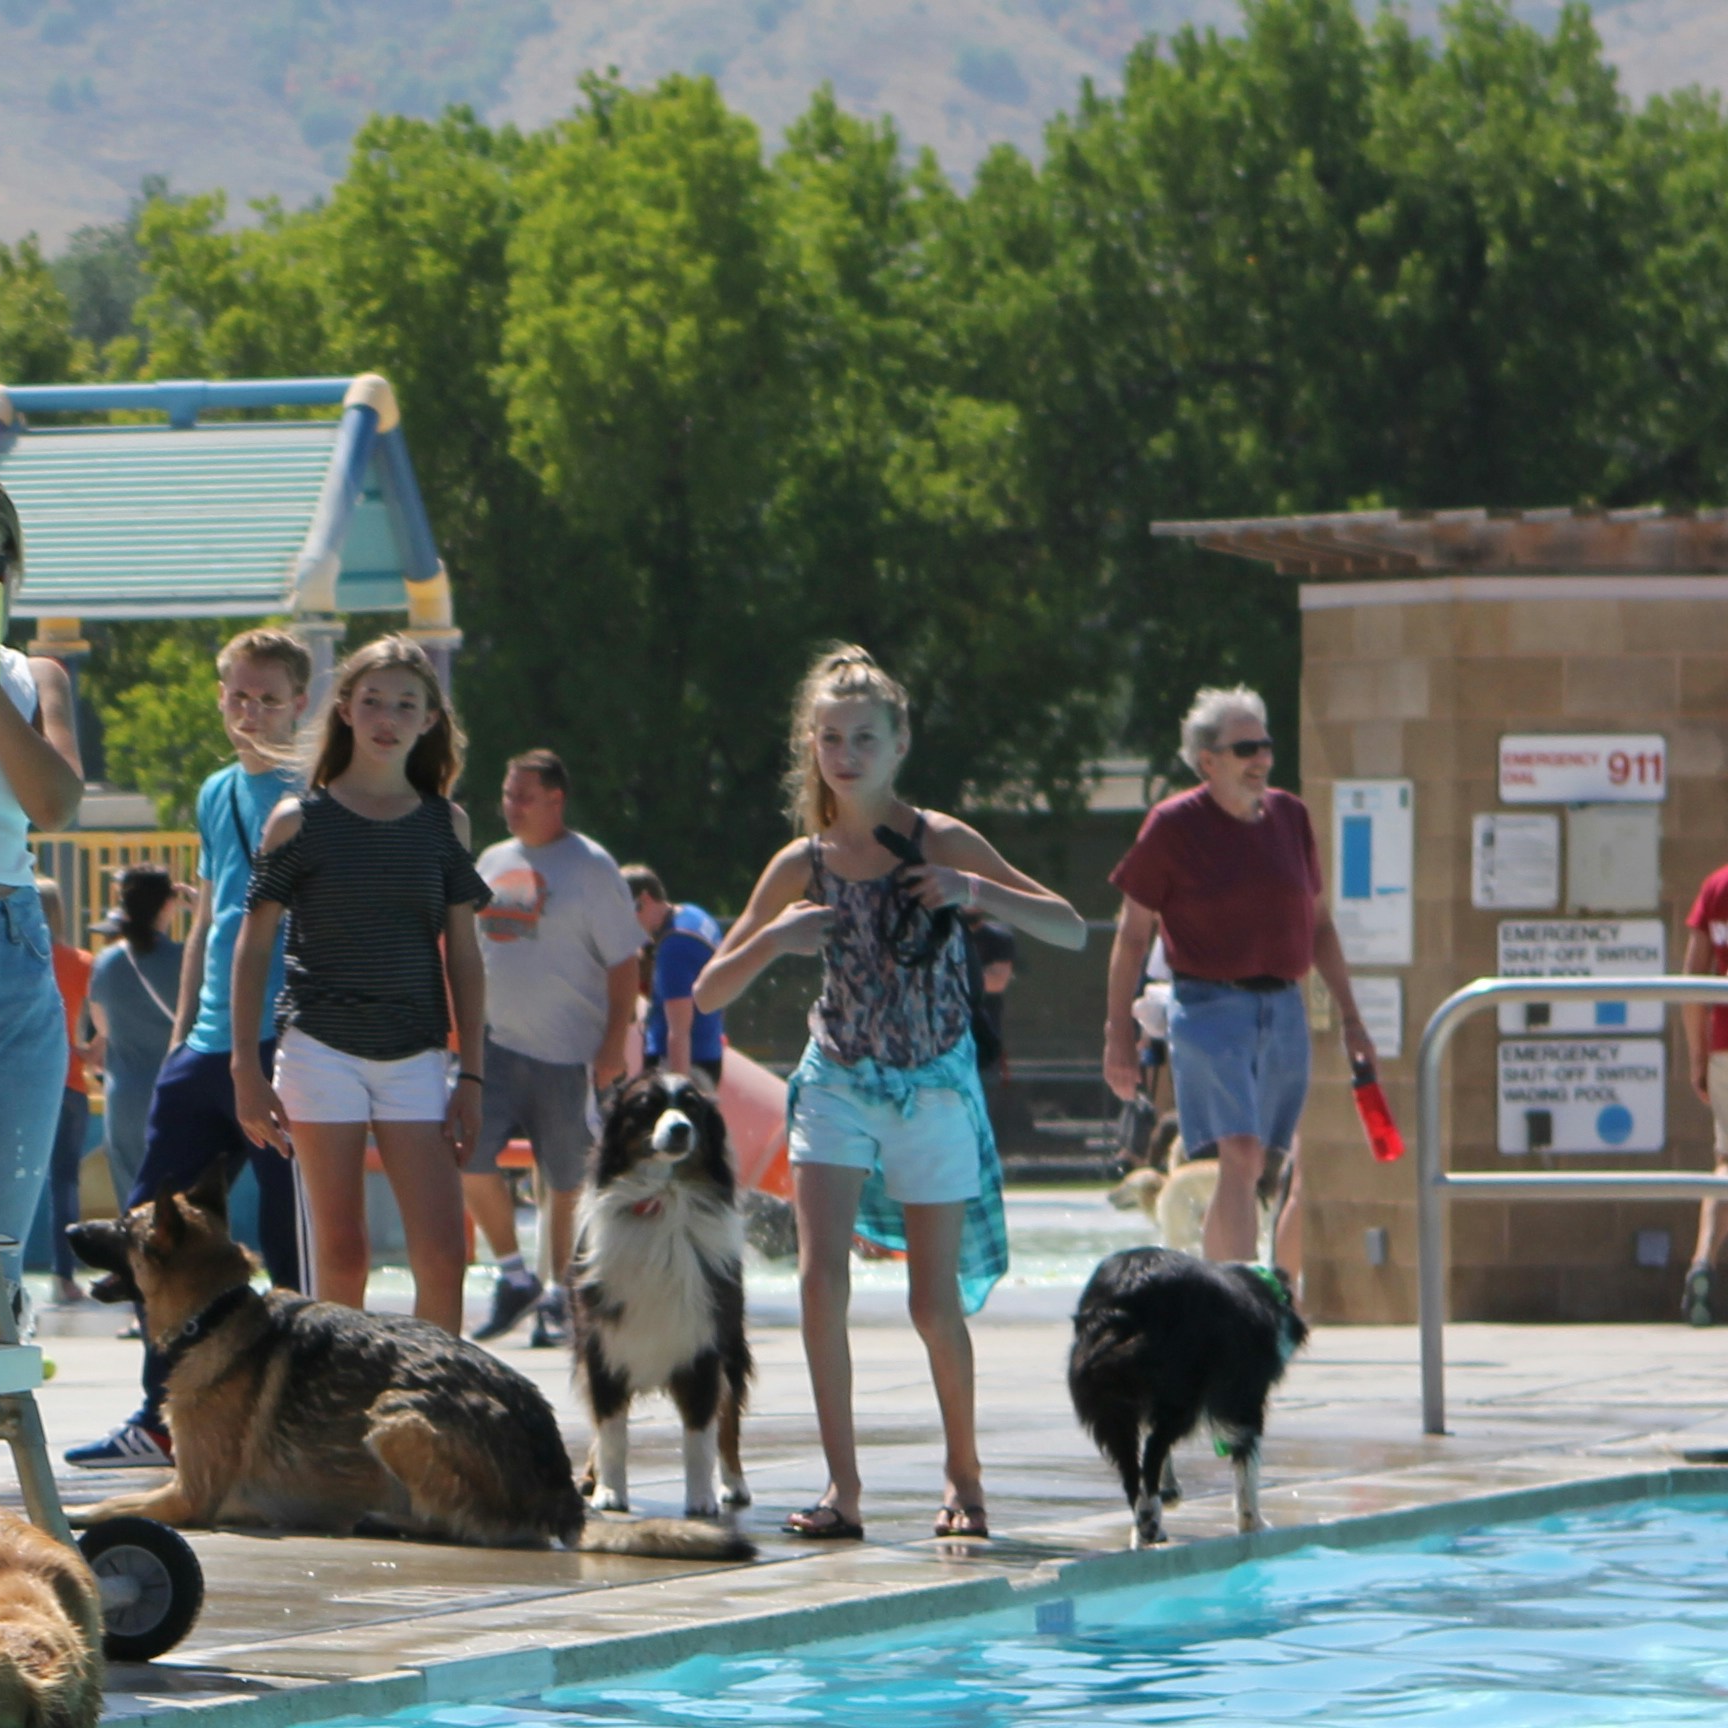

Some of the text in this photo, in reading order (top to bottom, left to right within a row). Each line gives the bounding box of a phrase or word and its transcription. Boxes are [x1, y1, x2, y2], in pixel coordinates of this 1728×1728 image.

[1502, 752, 1599, 767] EMERGENCY
[1608, 751, 1662, 785] 911
[1502, 926, 1620, 941] EMERGENCY
[1503, 947, 1658, 961] SHUT-OFF SWITCH
[1502, 1046, 1620, 1061] EMERGENCY
[1503, 1066, 1658, 1081] SHUT-OFF SWITCH
[1503, 1086, 1616, 1101] WADING POOL
